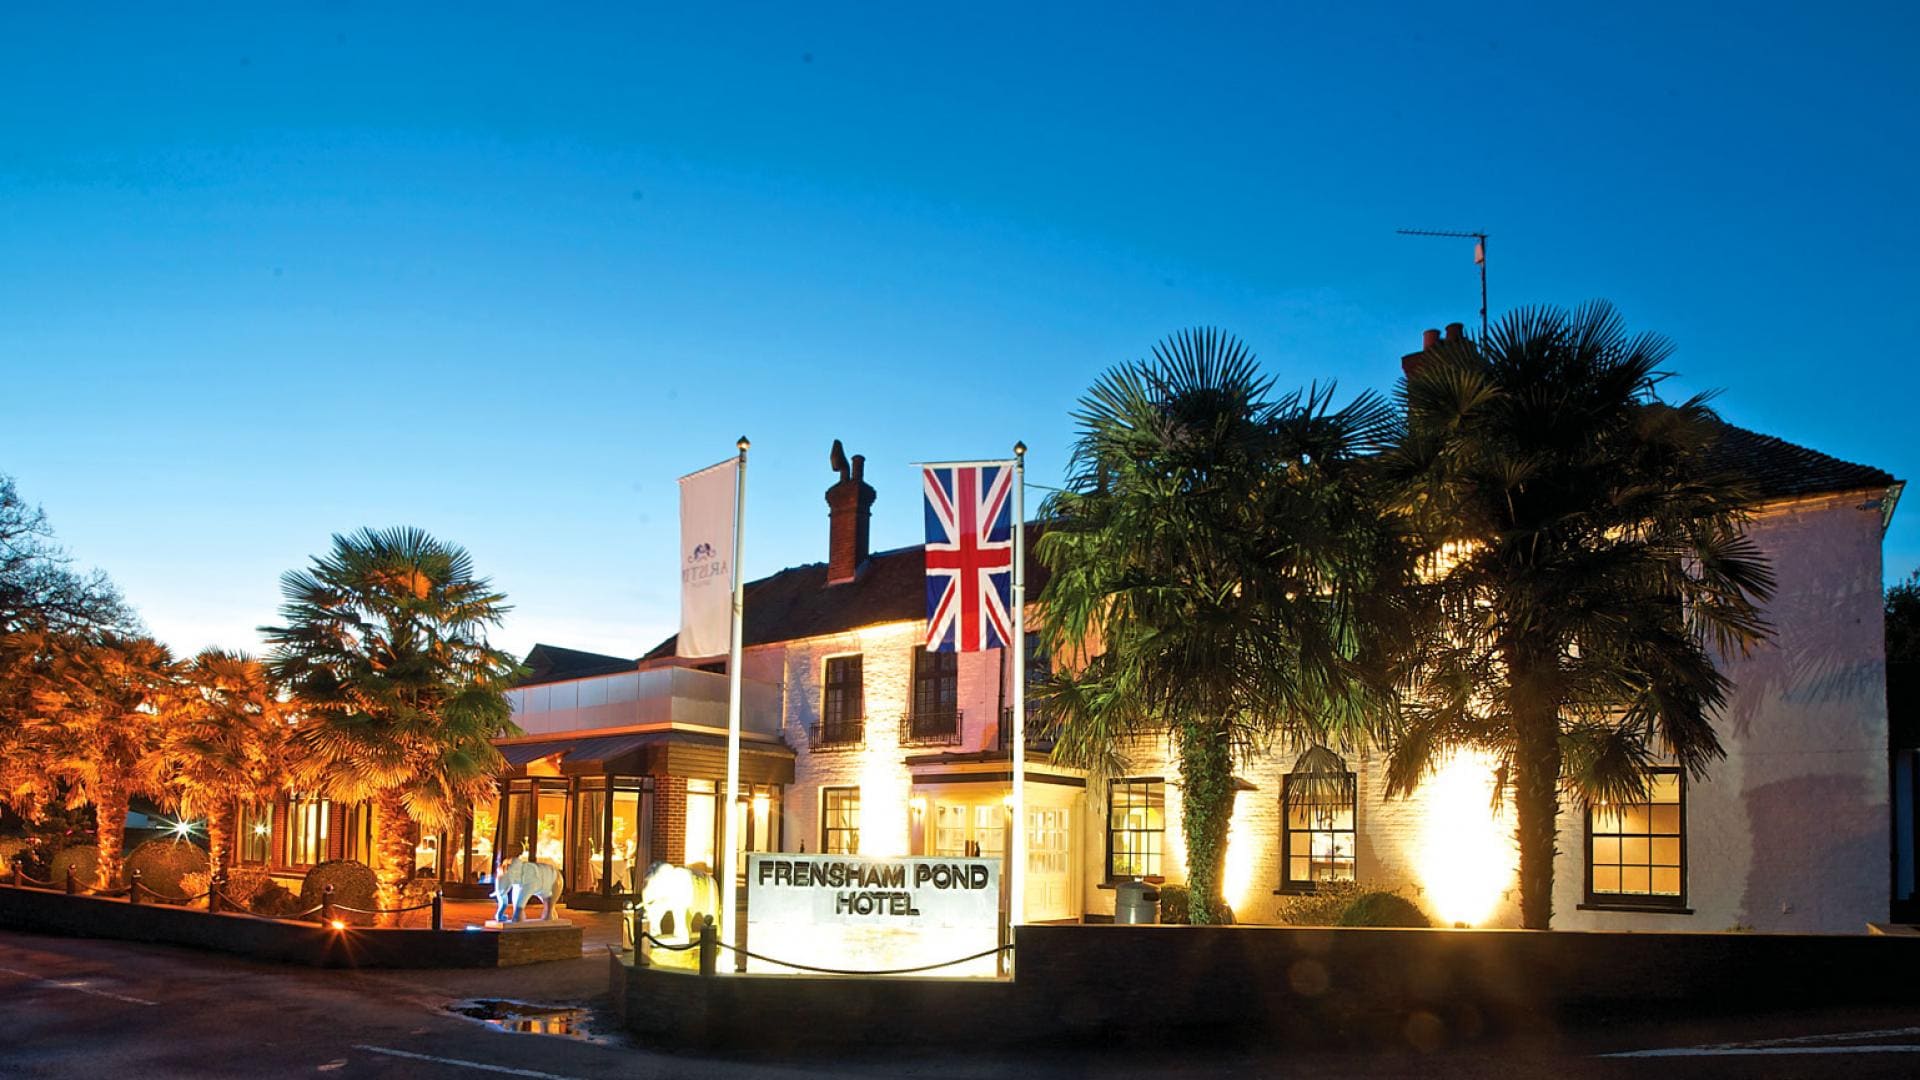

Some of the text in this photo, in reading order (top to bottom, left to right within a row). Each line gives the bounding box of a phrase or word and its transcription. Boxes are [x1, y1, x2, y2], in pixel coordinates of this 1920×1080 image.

[758, 860, 989, 890] FRENSHAM POND
[835, 891, 920, 915] HOTEL
